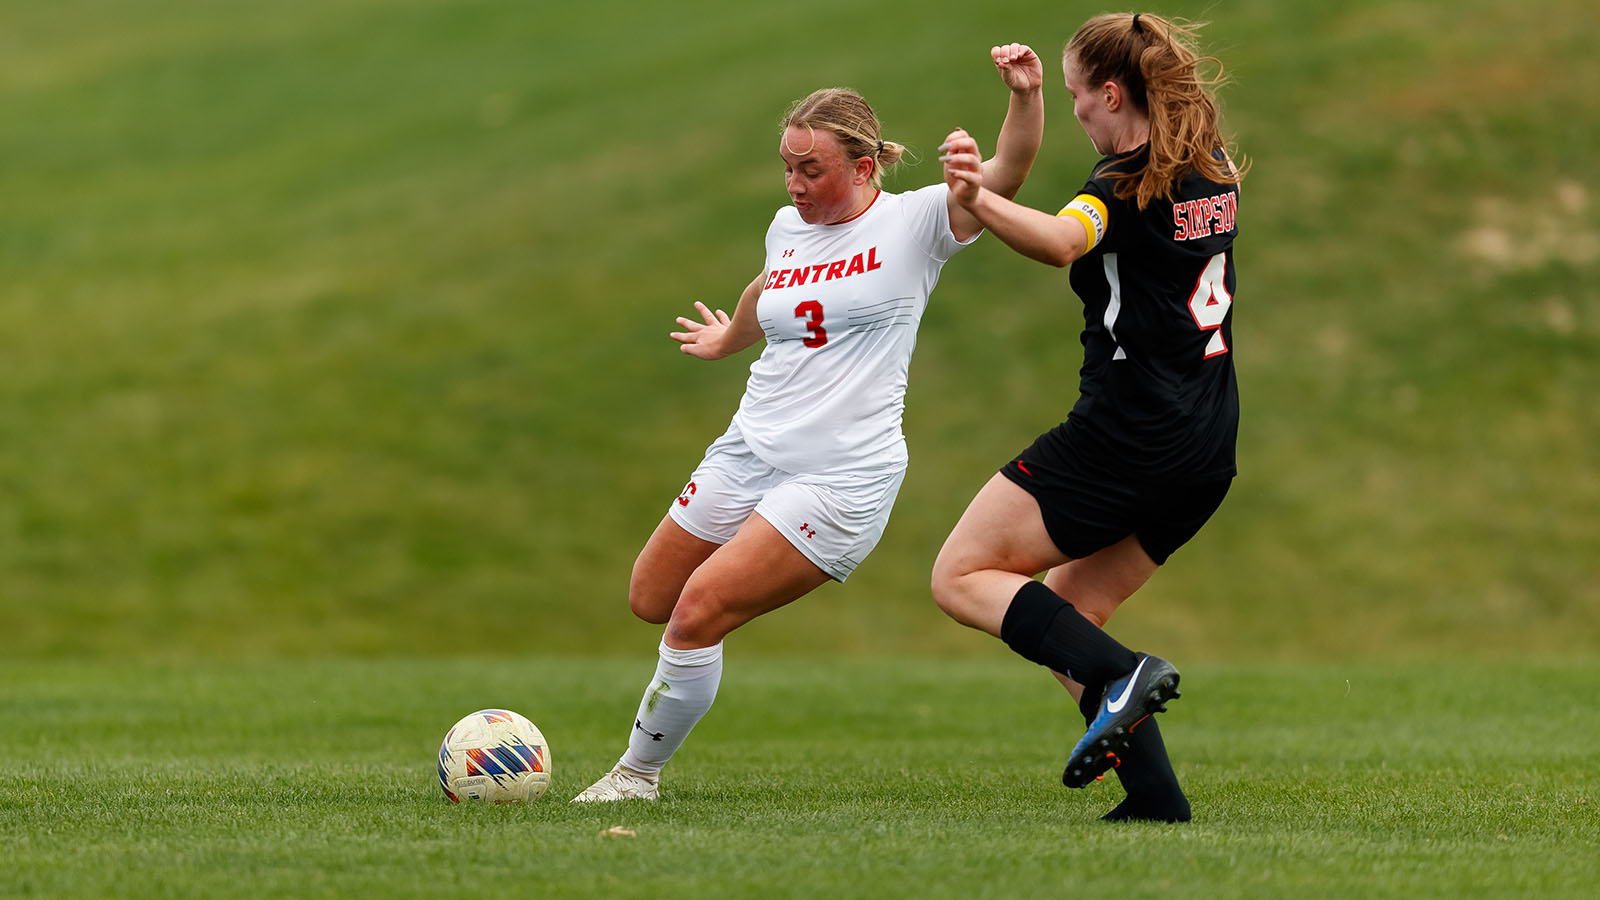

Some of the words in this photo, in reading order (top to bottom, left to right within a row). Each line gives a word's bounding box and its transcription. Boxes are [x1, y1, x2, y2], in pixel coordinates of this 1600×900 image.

[1173, 191, 1237, 241] SIMPSON
[764, 246, 883, 290] CENTRAL
[794, 300, 828, 348] 3
[1188, 251, 1233, 360] 4
